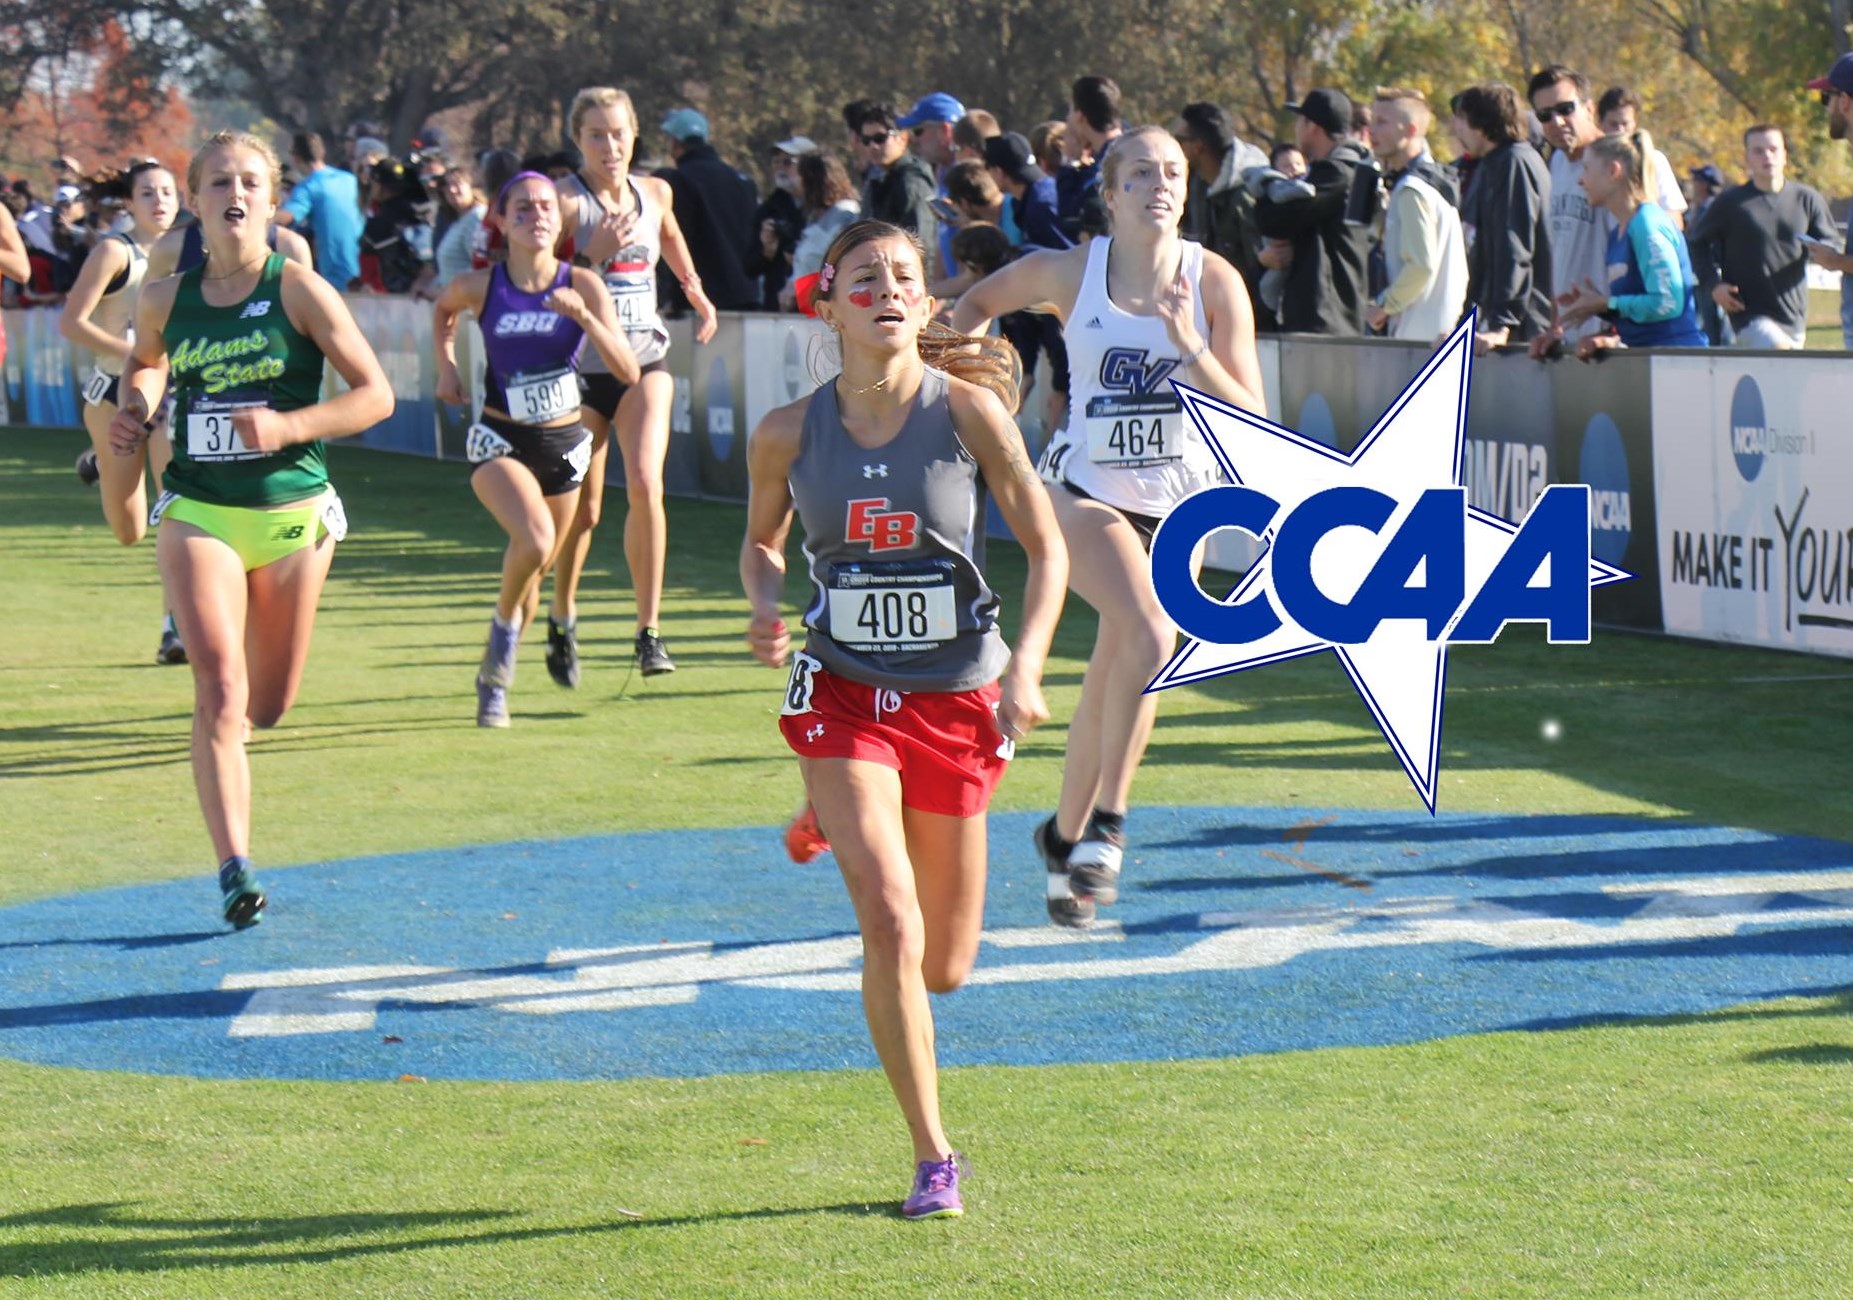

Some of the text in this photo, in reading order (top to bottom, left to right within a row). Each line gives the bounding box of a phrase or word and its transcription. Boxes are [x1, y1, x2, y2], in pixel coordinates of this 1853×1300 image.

[494, 311, 559, 338] SBU
[171, 329, 268, 378] Adams
[1100, 347, 1181, 396] GV
[201, 355, 285, 393] State
[523, 379, 564, 415] 599
[206, 416, 236, 452] 37
[1108, 418, 1165, 456] 464
[1734, 426, 1764, 455] NCAA
[845, 498, 923, 552] EB
[1591, 490, 1632, 533] NCAA
[1673, 530, 1743, 589] MAKE
[1751, 537, 1774, 592] IT
[858, 592, 927, 638] 408
